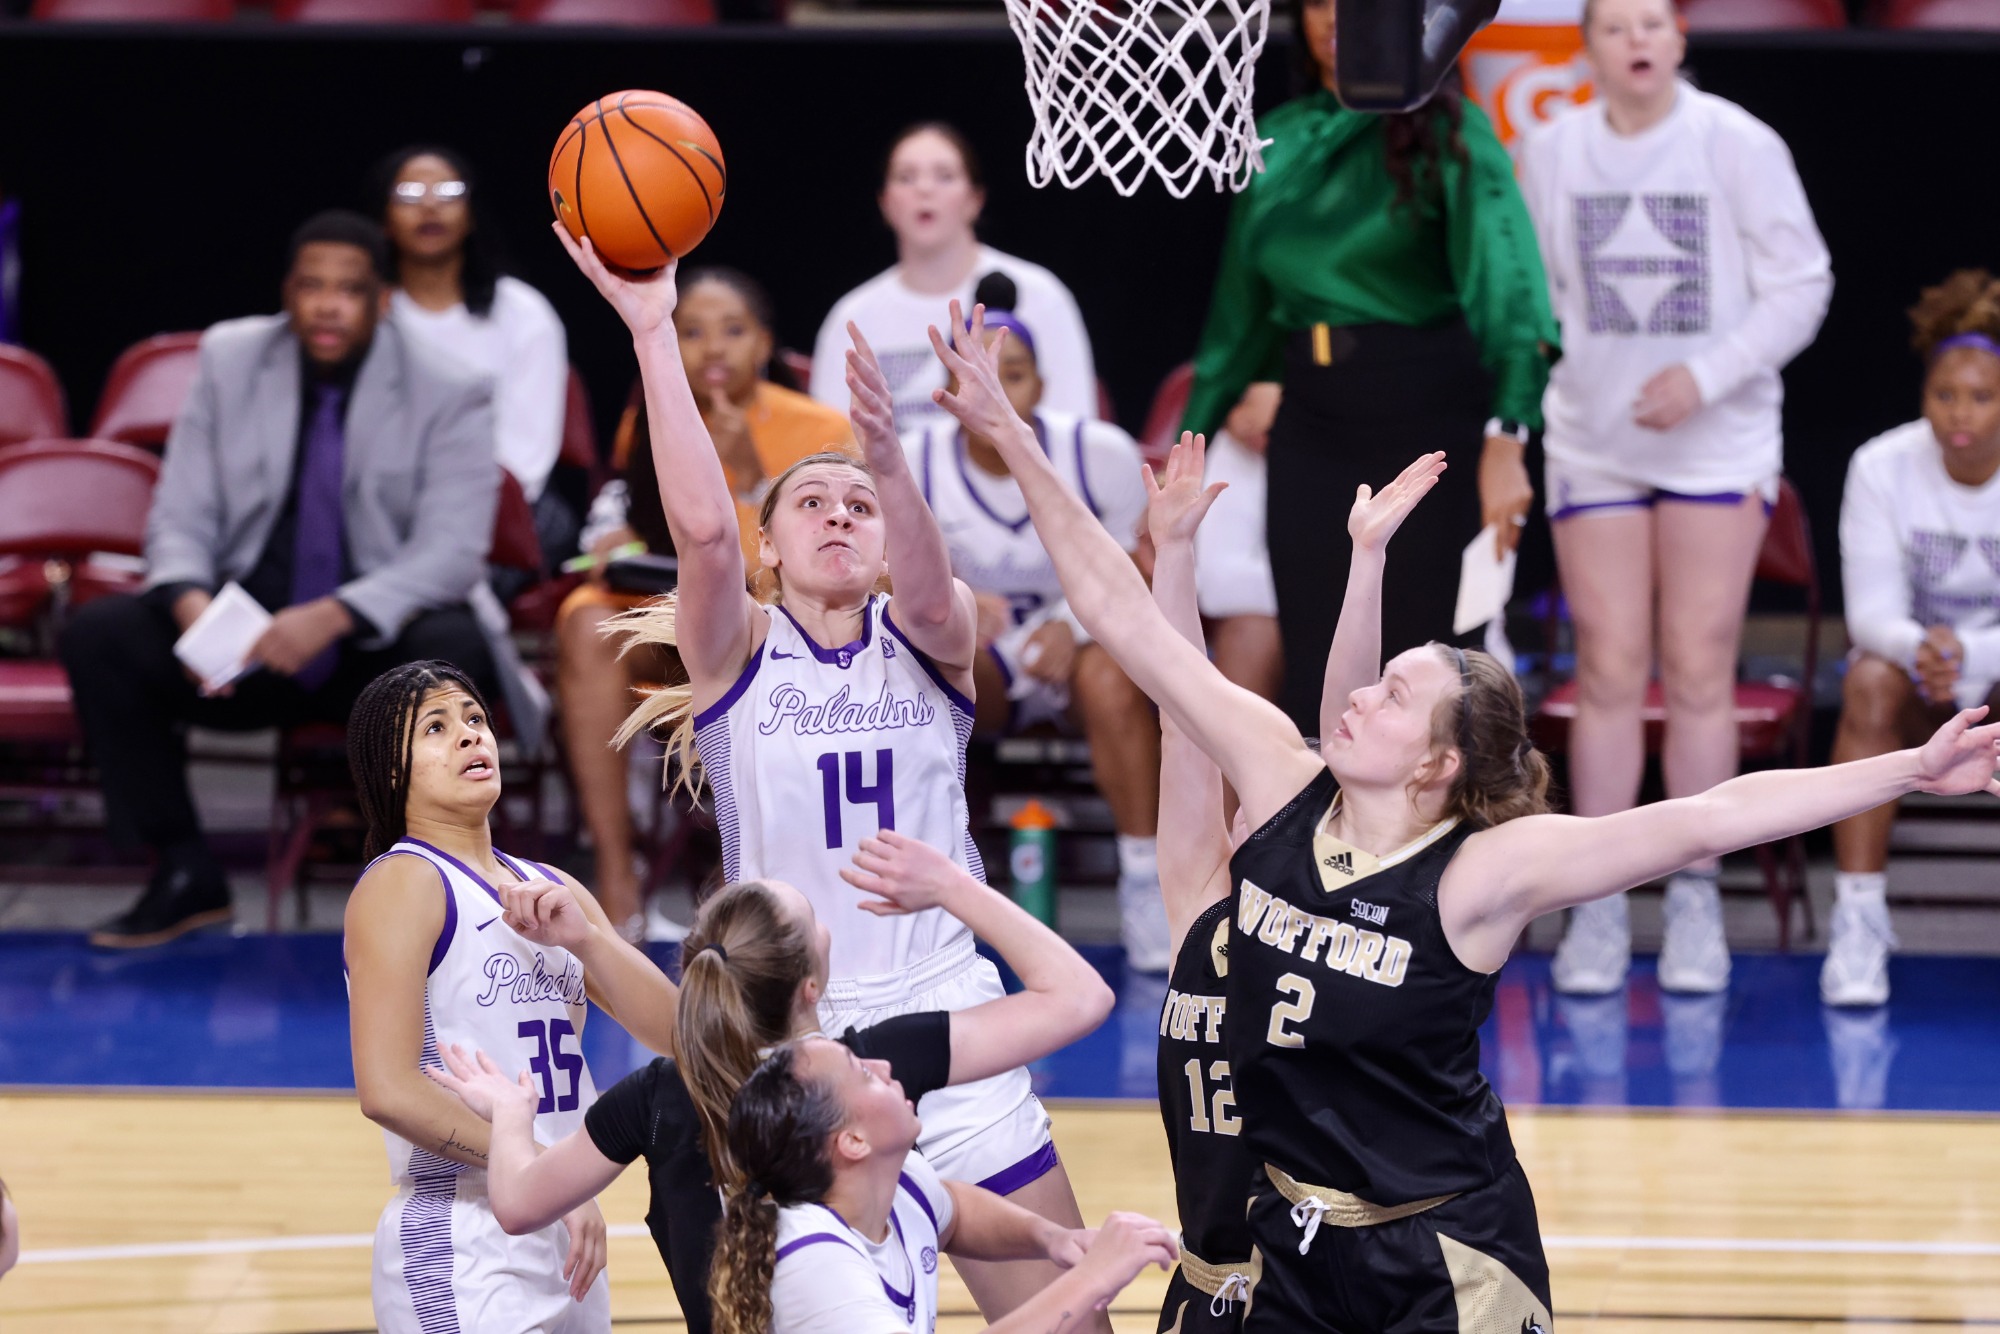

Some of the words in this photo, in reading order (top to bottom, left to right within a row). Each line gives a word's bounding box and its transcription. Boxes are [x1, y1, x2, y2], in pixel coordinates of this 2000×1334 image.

[759, 680, 935, 735] Paladins
[817, 748, 896, 850] 14
[1323, 858, 1355, 876] adidas
[1237, 878, 1413, 988] WOFFORD
[1266, 972, 1316, 1049] 2
[518, 1018, 584, 1114] 35
[1184, 1058, 1243, 1137] 12
